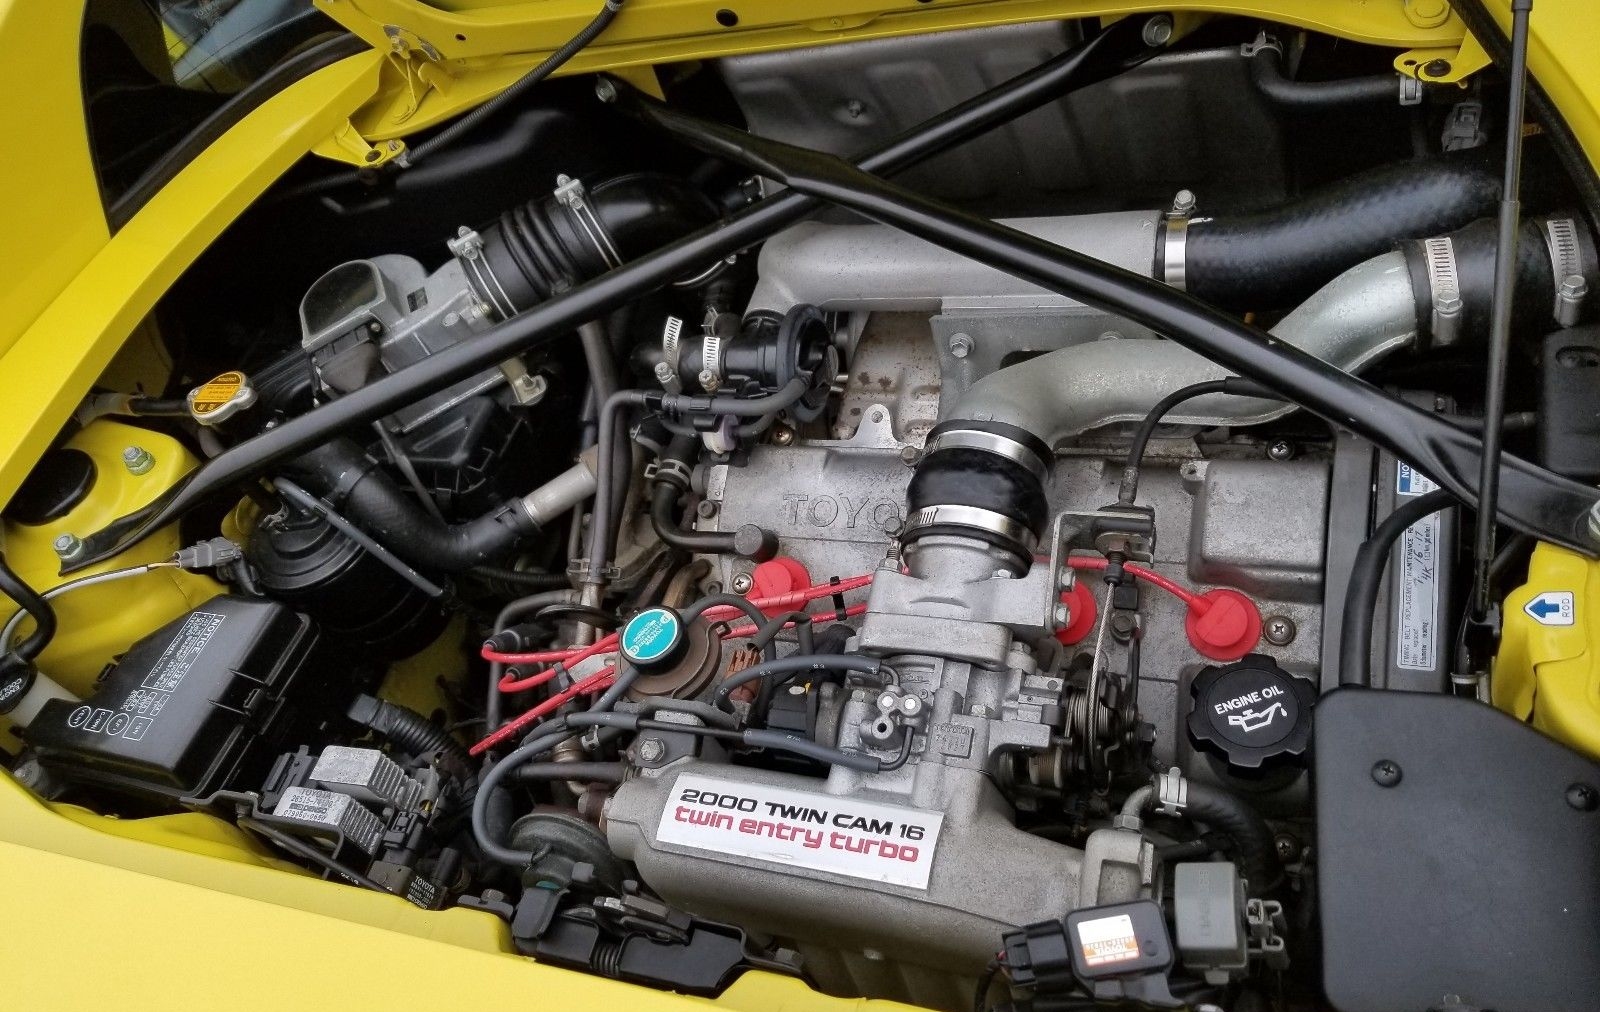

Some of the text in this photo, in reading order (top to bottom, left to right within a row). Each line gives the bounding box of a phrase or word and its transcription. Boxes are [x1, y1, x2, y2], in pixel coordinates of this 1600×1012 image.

[782, 494, 902, 532] TOYO
[1406, 538, 1414, 577] MAINTENANCE
[1405, 578, 1413, 620] REPLACEMENT
[1561, 598, 1570, 618] ROD
[190, 618, 221, 654] NOTICE
[1214, 685, 1284, 715] ENGINE OIL
[679, 788, 926, 841] 2000 TWIN CAM 16
[674, 805, 920, 863] twin entry turbo
[415, 875, 435, 894] TOYOTA
